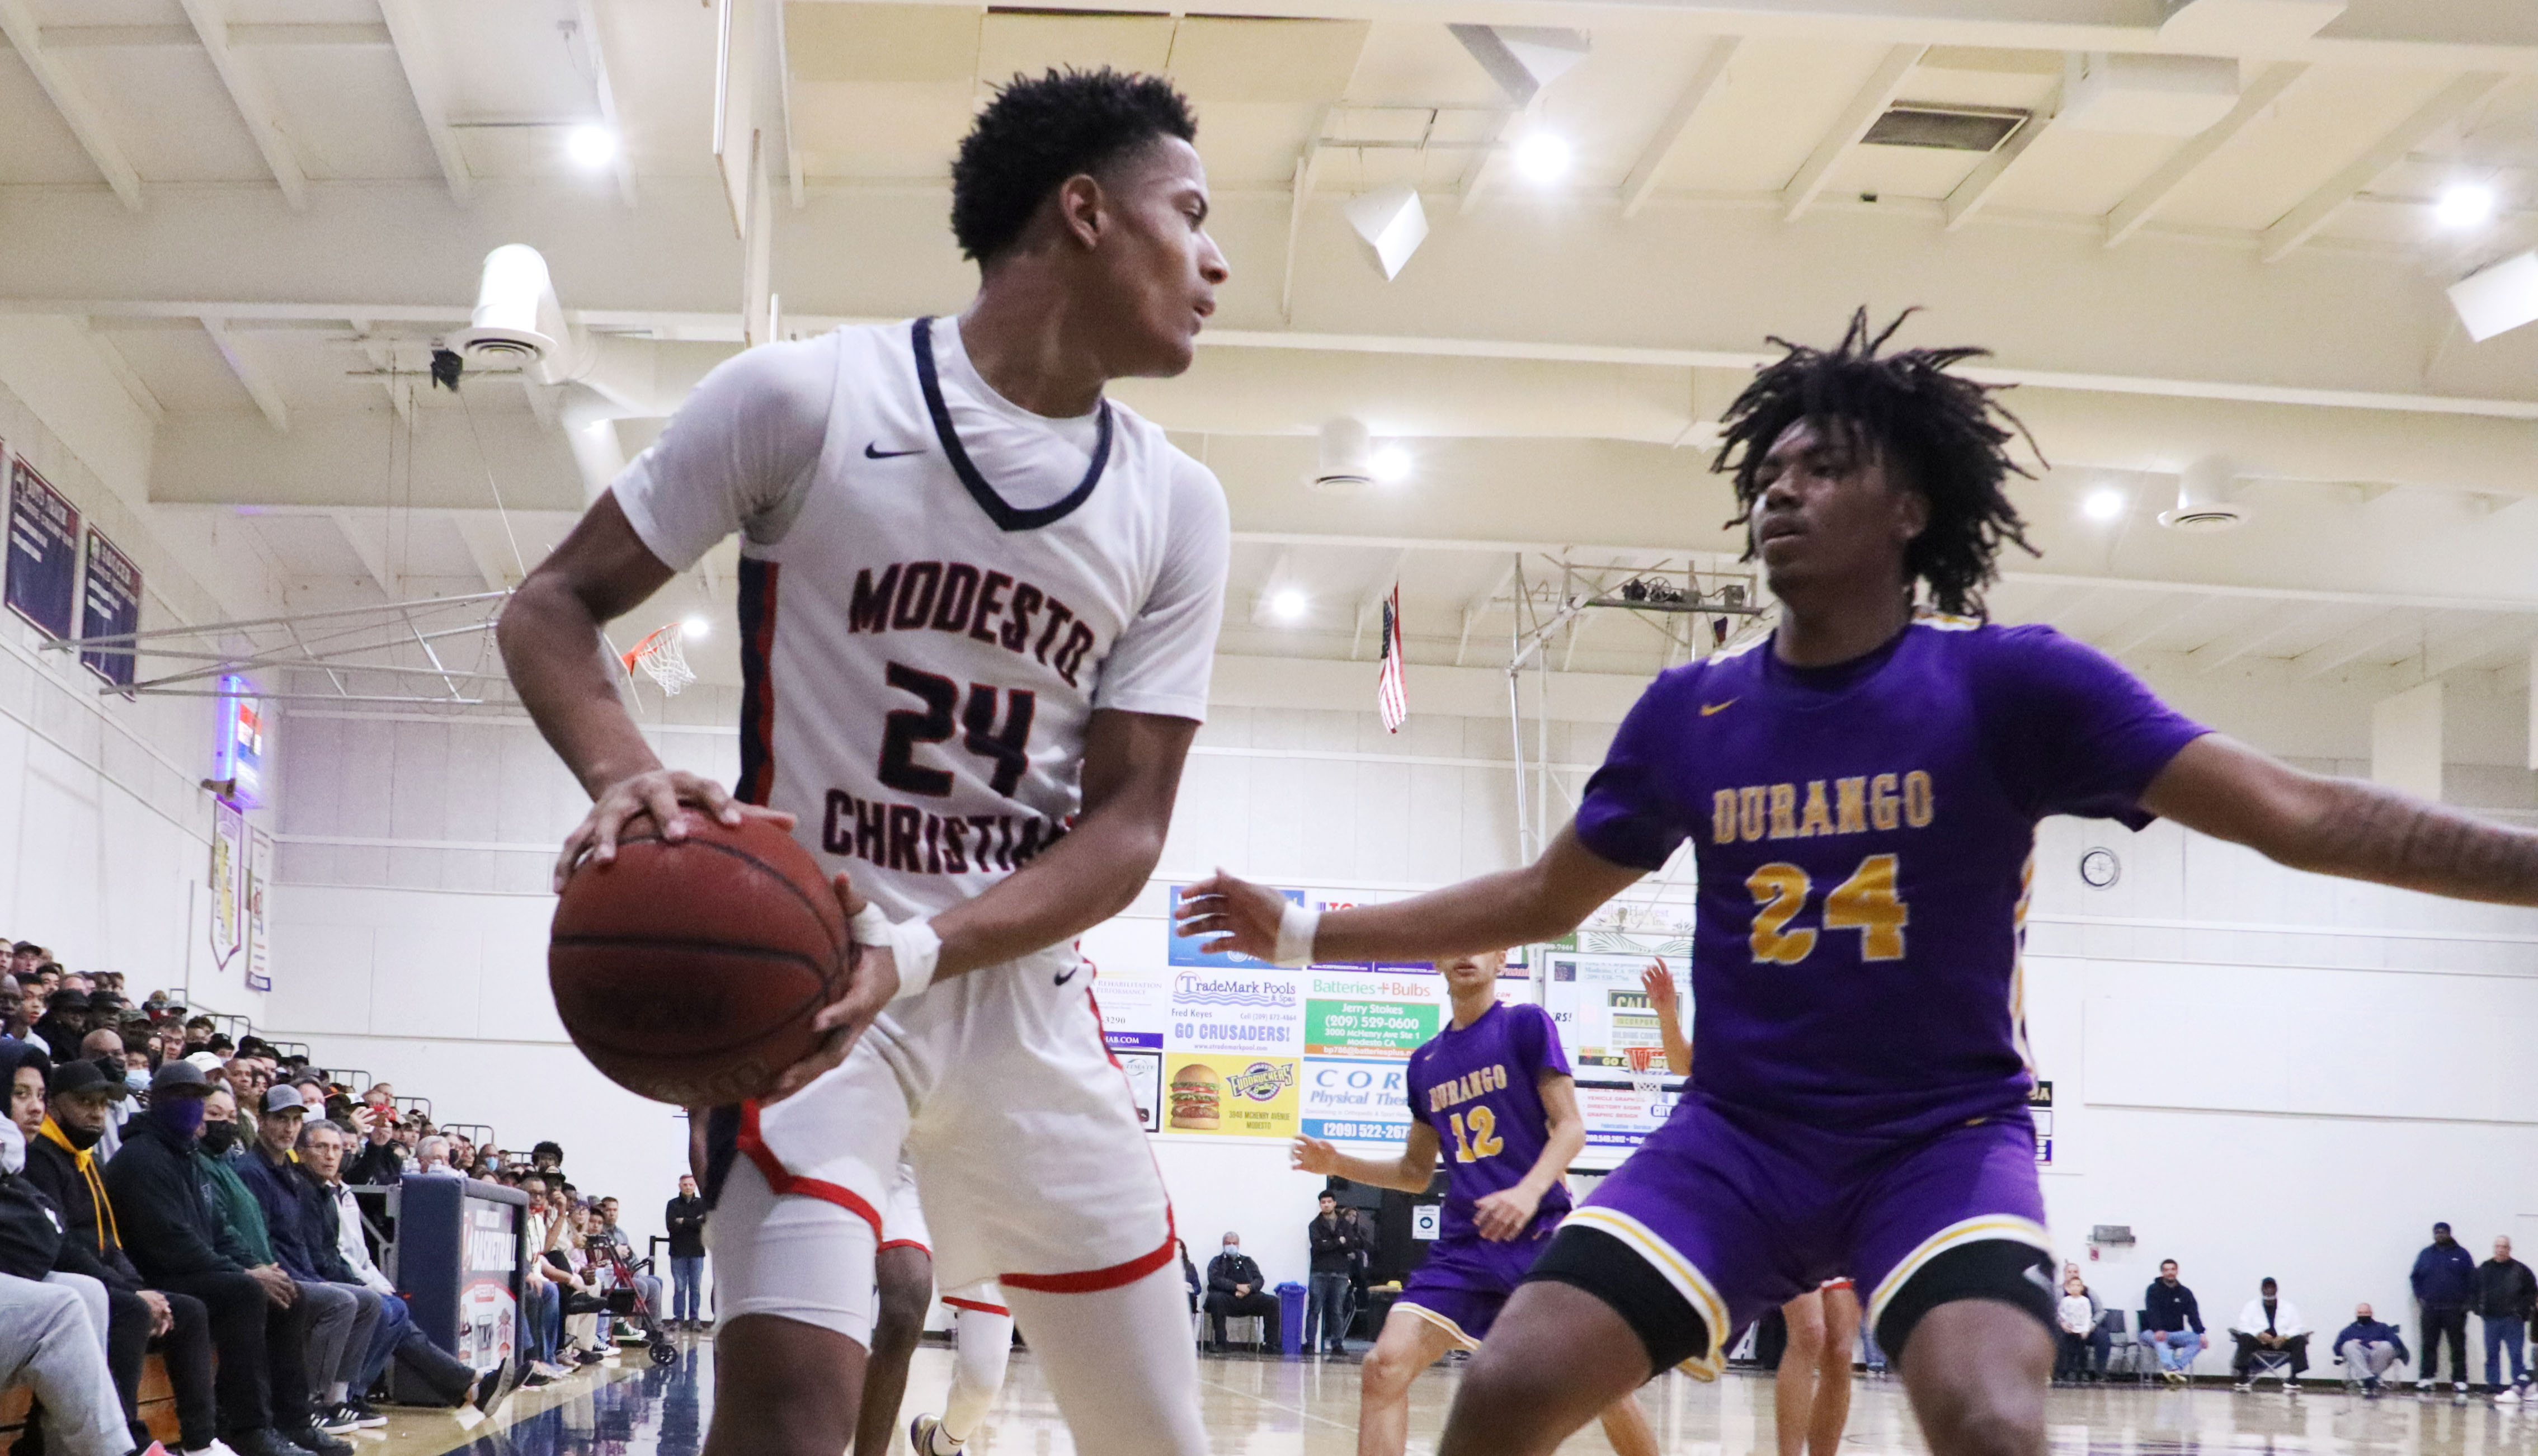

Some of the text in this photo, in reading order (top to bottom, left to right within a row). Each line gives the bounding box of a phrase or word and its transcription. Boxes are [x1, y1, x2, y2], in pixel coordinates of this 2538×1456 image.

[848, 561, 1095, 688] MODESTO
[877, 661, 1036, 797] 24
[1712, 770, 1934, 844] DURANGO
[1745, 853, 1909, 965] 24
[1180, 976, 1296, 995] TradeMark Pools
[1313, 979, 1376, 995] Batteries
[1392, 982, 1430, 997] Bulbs
[1172, 1009, 1213, 1019] Fred Keyes
[1341, 1003, 1404, 1015] Jerry Stokes
[1553, 1012, 1572, 1023] RS!
[1325, 1014, 1420, 1030] (209) 529-0600
[1175, 1023, 1291, 1042] GO CRUSADERS!
[1325, 1028, 1345, 1036] 3000
[1346, 1038, 1396, 1047] Modesto CA
[1230, 1065, 1294, 1097] FUDDRUCKERS
[1428, 1064, 1508, 1113] DURANGO
[1310, 1090, 1370, 1108] Physical
[1246, 1121, 1272, 1130] MODESTO
[1322, 1122, 1411, 1139] (209) 522-267
[1449, 1105, 1504, 1163] 12
